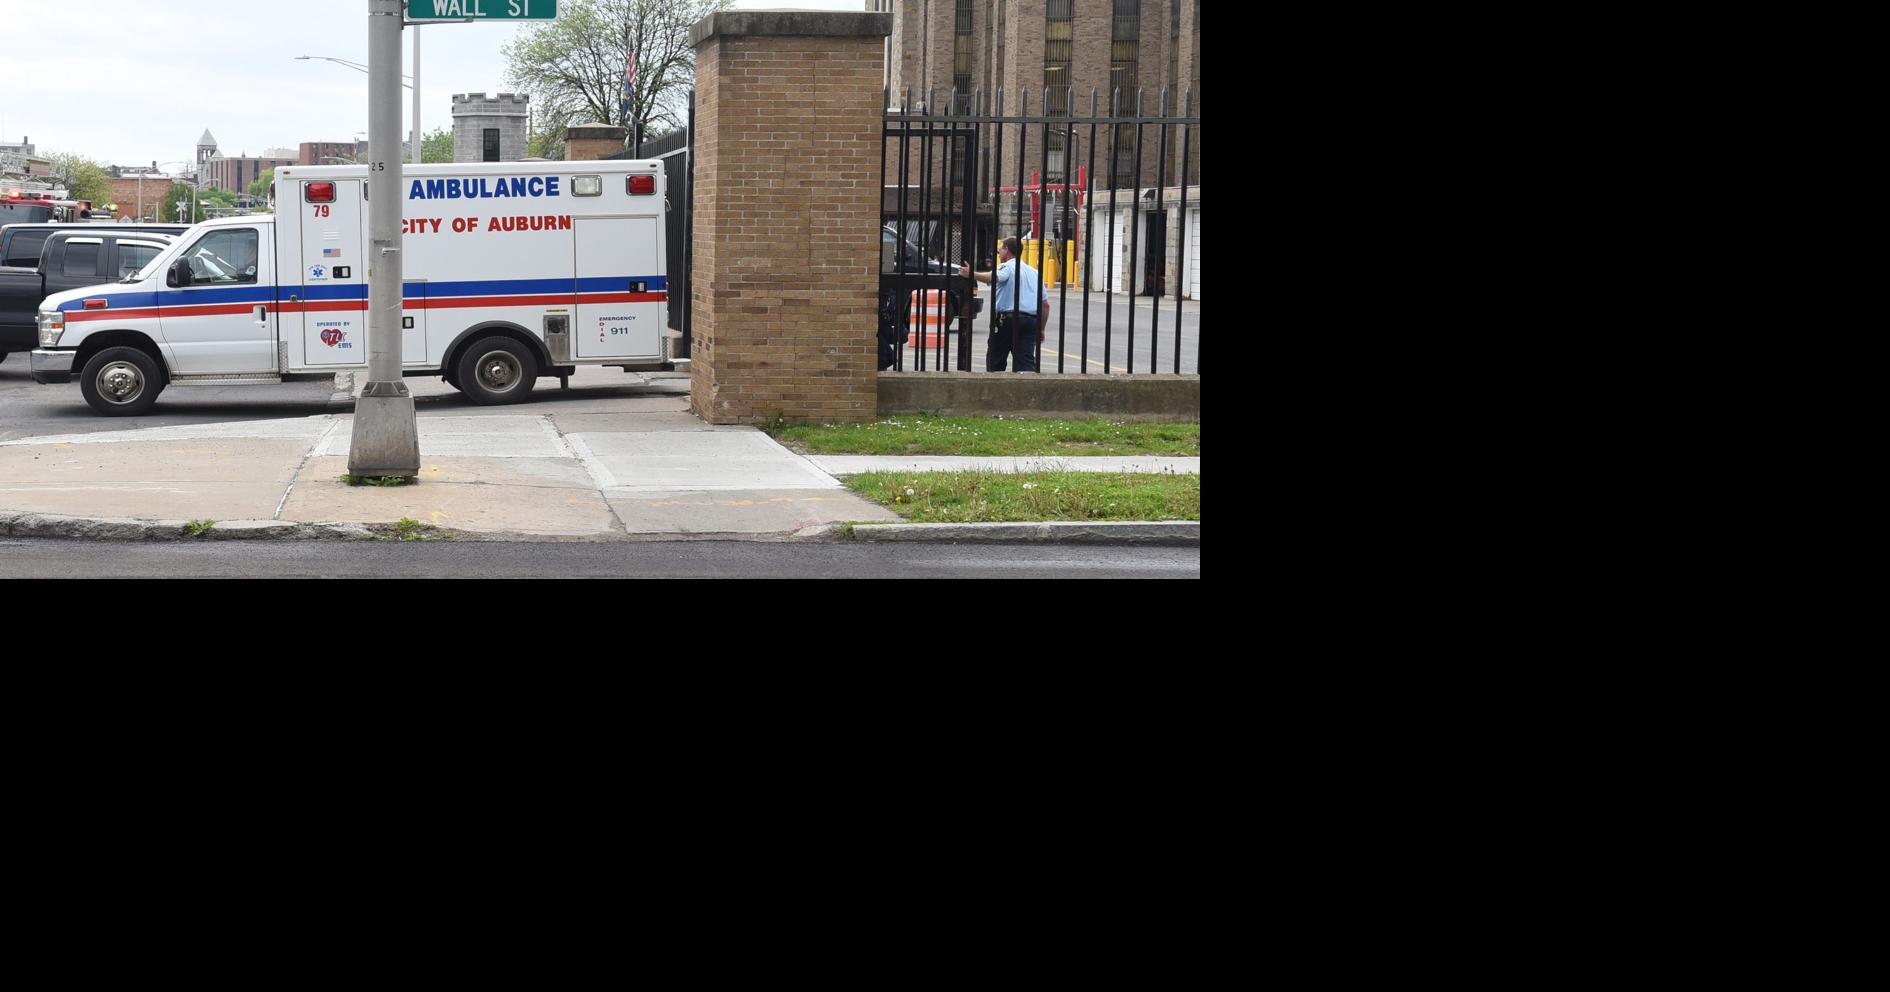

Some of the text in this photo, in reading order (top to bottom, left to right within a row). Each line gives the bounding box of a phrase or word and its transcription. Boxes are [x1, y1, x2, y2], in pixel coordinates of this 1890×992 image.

[433, 0, 529, 17] WALL ST
[409, 176, 560, 199] AMBULANCE
[313, 204, 330, 217] 79
[452, 217, 479, 233] OF
[488, 215, 571, 232] AUBURN
[611, 327, 628, 335] 911
